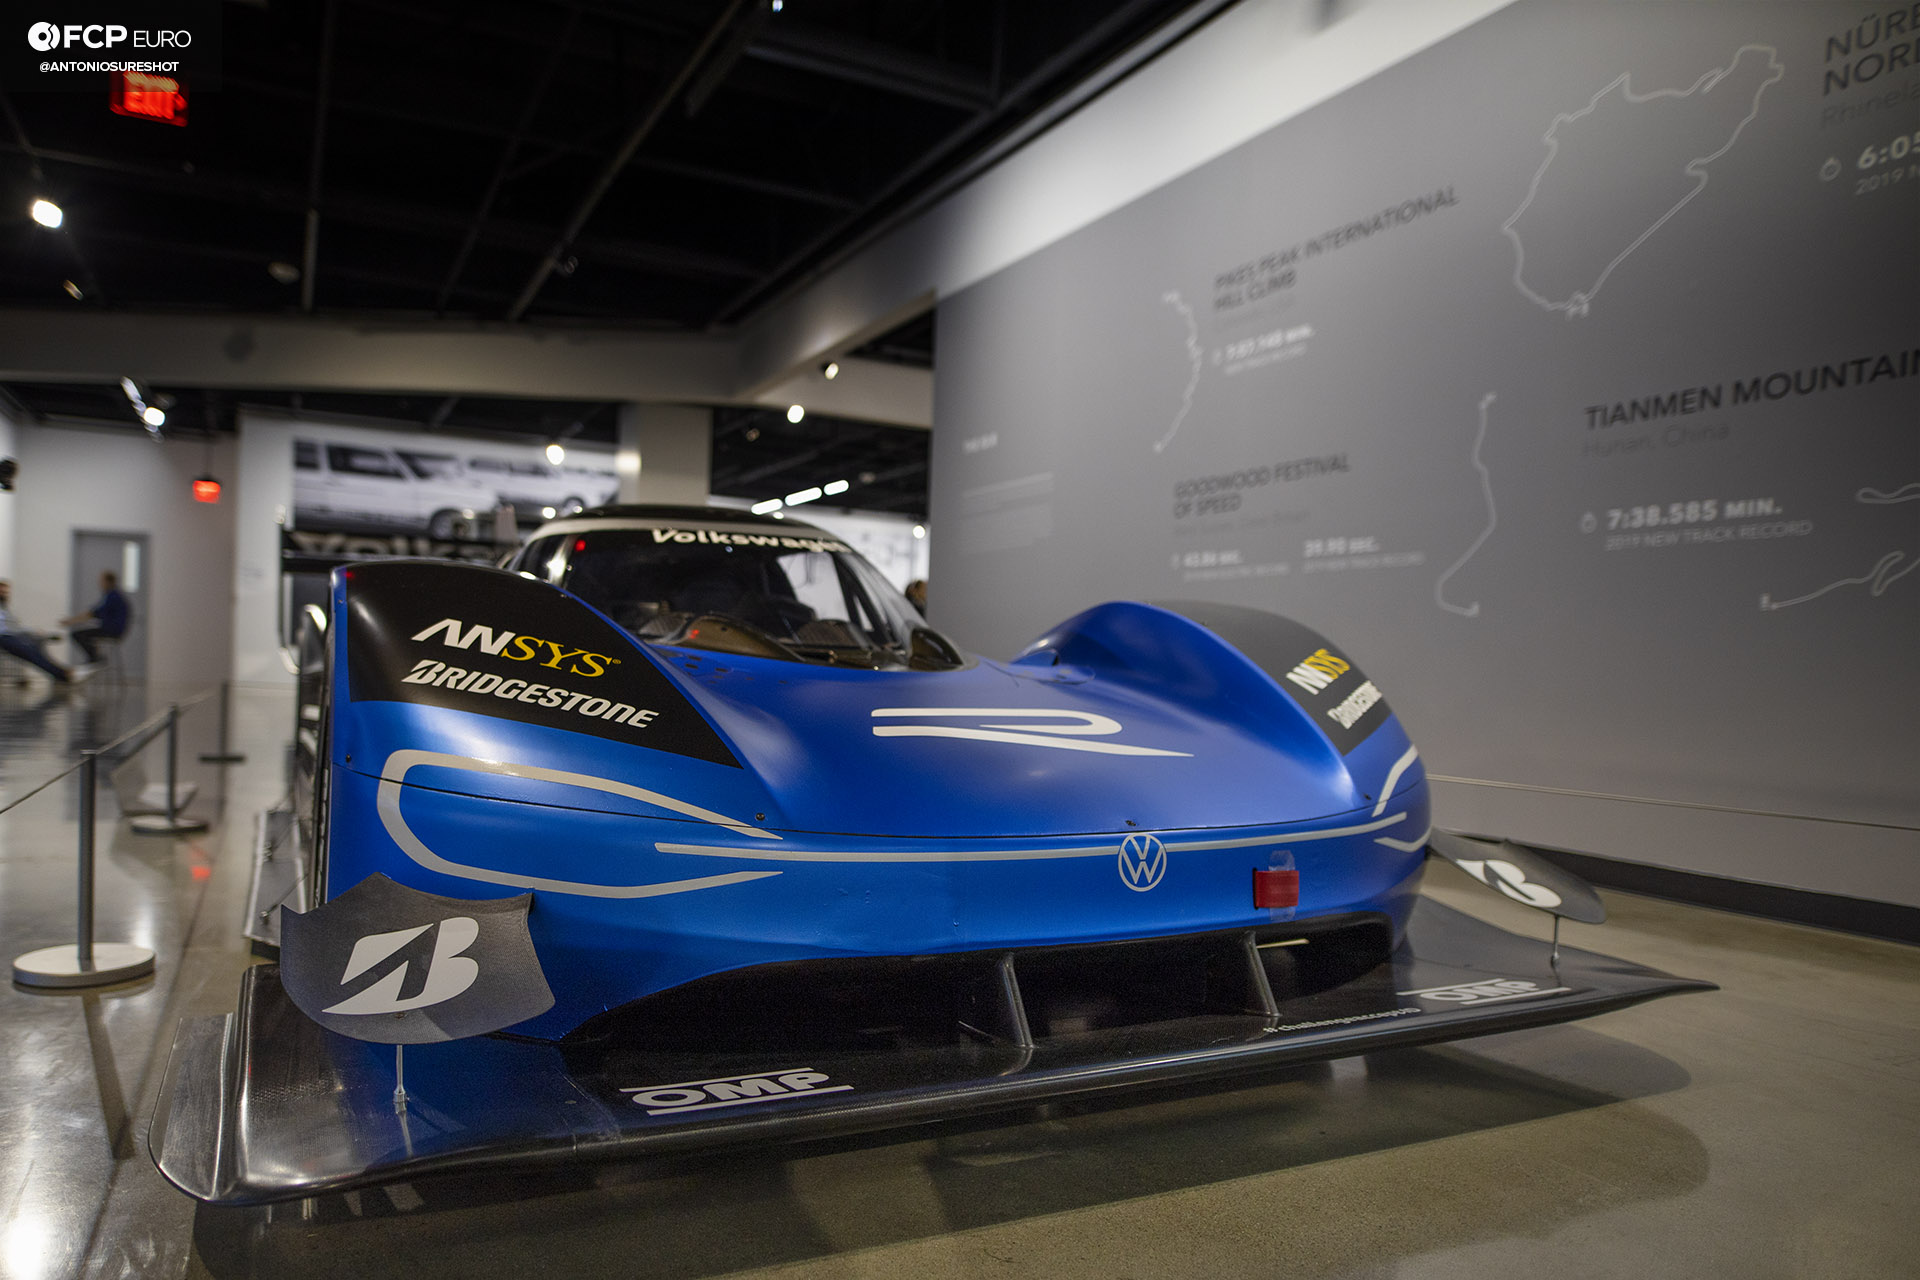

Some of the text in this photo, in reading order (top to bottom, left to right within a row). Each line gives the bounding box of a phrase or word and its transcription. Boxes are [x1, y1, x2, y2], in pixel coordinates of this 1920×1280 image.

[1823, 35, 1920, 97] NOR
[1305, 184, 1460, 258] INTERNATIONAL
[1585, 383, 1722, 431] TIANMEN
[1606, 499, 1718, 531] 7:38.585
[1683, 525, 1736, 545] TRACK
[1739, 519, 1814, 542] RECORD
[632, 1072, 829, 1107] OMP
